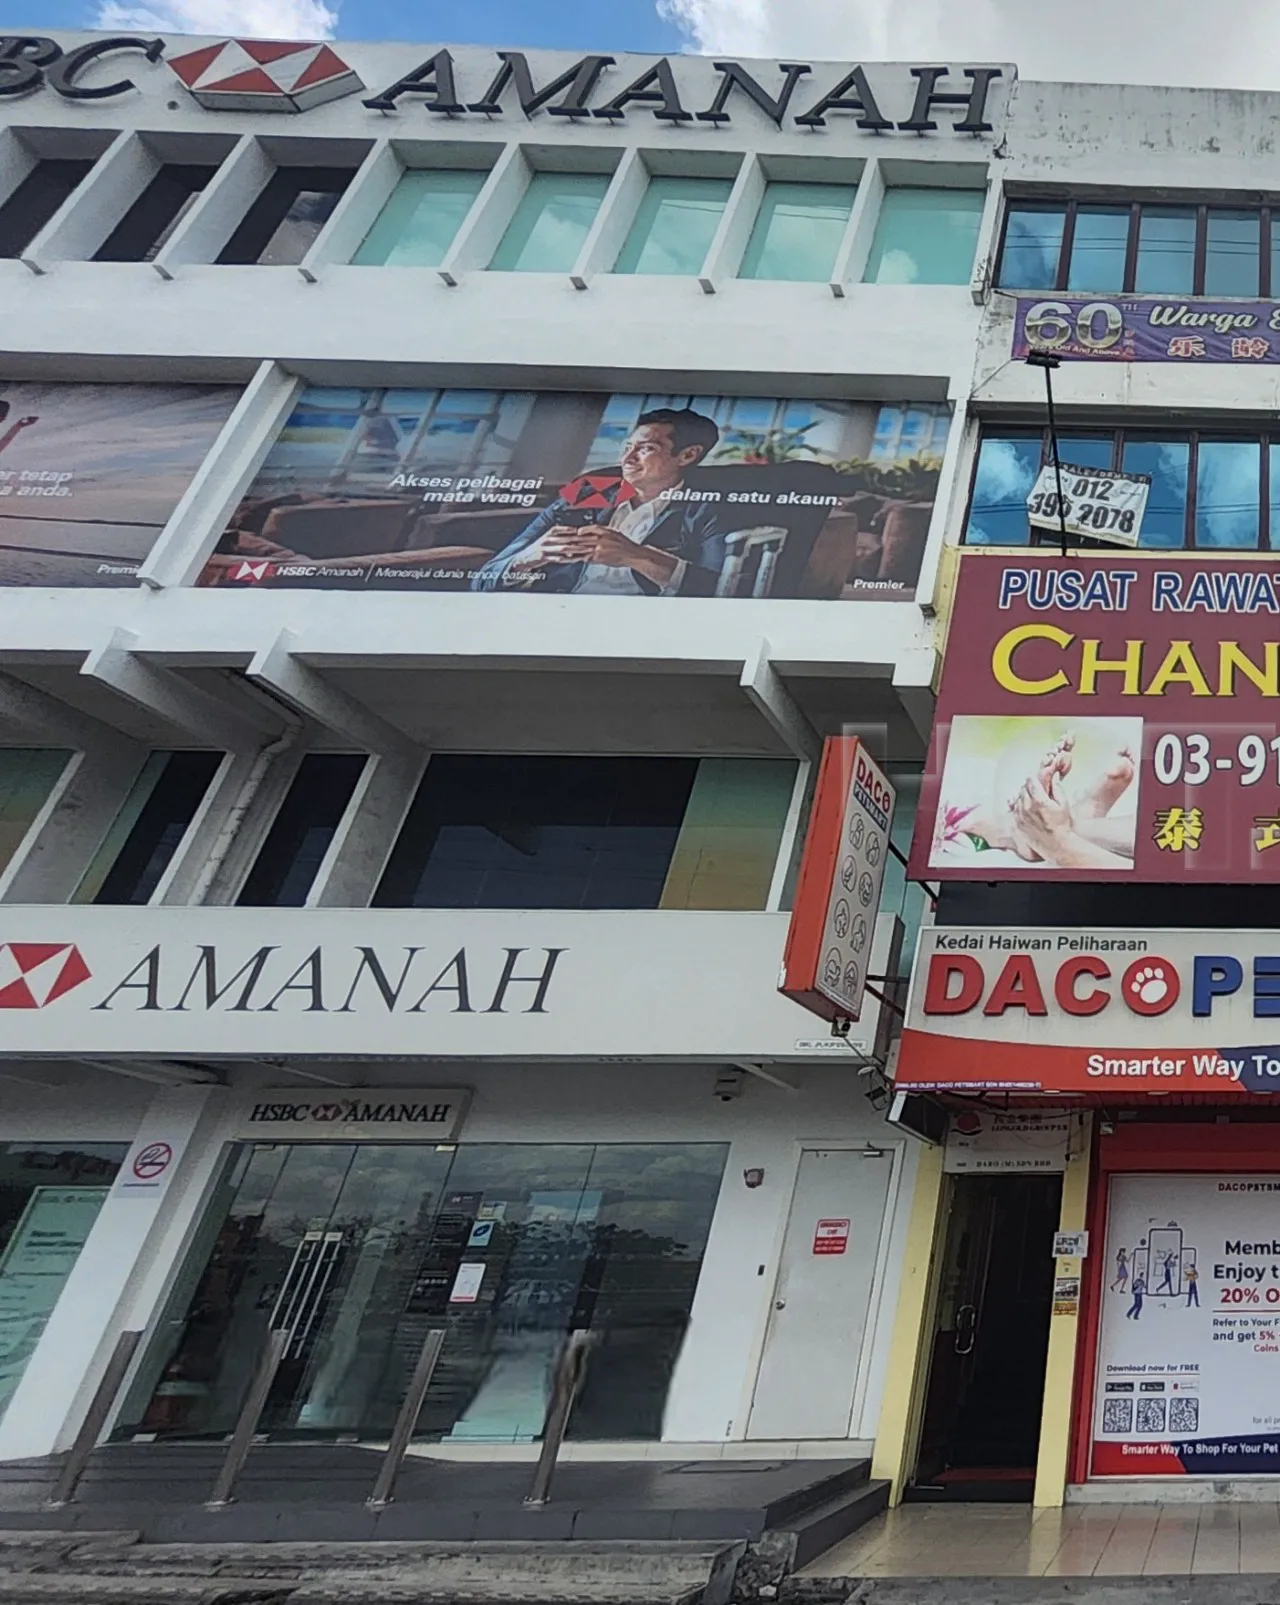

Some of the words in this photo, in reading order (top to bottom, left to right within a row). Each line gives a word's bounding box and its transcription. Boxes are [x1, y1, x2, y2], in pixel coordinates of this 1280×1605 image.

[362, 48, 1002, 134] AMANAH
[1024, 301, 1123, 348] 60
[1150, 305, 1257, 334] Warga
[19, 470, 73, 488] tetap
[389, 473, 451, 489] Akses
[456, 475, 544, 491] pelbagai
[16, 486, 72, 497] anda.
[423, 491, 474, 503] mata
[480, 493, 537, 507] wang
[659, 488, 721, 502] dalam
[726, 491, 771, 504] satu
[776, 492, 843, 506] akaun.
[1072, 478, 1114, 502] 012
[1076, 503, 1136, 534] 2078
[97, 563, 139, 575] Premi
[276, 566, 316, 577] HSBC
[316, 566, 364, 577] Amanah
[433, 568, 464, 579] dunia
[501, 570, 546, 582] batasan
[853, 579, 905, 590] Premier
[998, 568, 1137, 611] PUSAT
[856, 755, 890, 814] DACO
[935, 934, 984, 949] Kedai
[989, 935, 1051, 951] Haiwan
[1057, 935, 1148, 951] Peliharaan
[89, 943, 571, 1014] AMANAH
[1086, 1054, 1186, 1077] Smarter
[1192, 1055, 1245, 1081] Way
[249, 1104, 310, 1122] HSBC
[341, 1104, 451, 1122] AMANAH
[1213, 1264, 1266, 1282] Enjoy
[1220, 1288, 1260, 1304] 20%
[1212, 1318, 1237, 1327] Refer
[1239, 1318, 1249, 1327] to
[1251, 1318, 1272, 1327] Your
[1213, 1331, 1234, 1341] and
[1237, 1331, 1256, 1344] get
[1259, 1331, 1275, 1341] 5%
[1253, 1344, 1279, 1353] Coins
[1106, 1364, 1147, 1372] Download
[1167, 1364, 1178, 1372] for
[1122, 1444, 1159, 1455] Smarter
[1160, 1444, 1180, 1456] Way
[1182, 1444, 1193, 1454] To
[1195, 1444, 1220, 1457] Shop
[1222, 1444, 1237, 1454] For
[1239, 1443, 1262, 1454] Your
[1263, 1443, 1278, 1454] Pet
